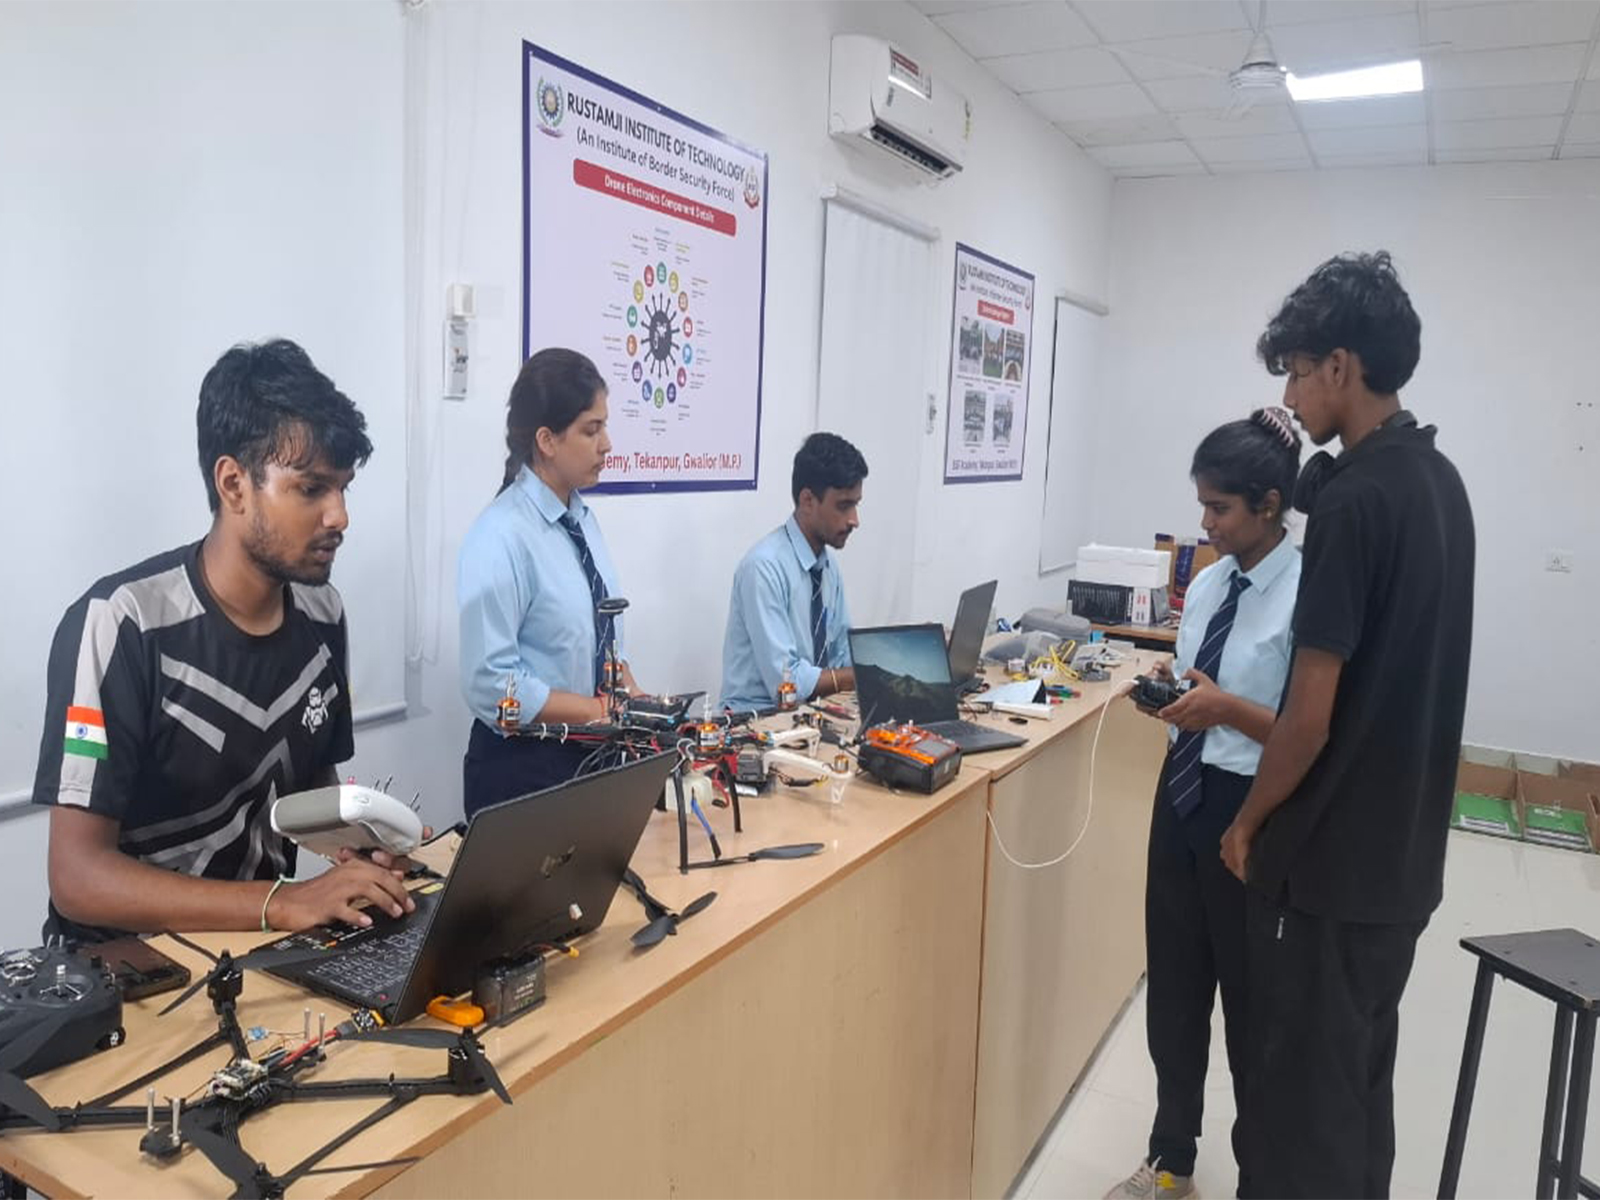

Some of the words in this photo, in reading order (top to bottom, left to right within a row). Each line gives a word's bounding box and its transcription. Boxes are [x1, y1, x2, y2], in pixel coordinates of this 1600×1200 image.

[567, 92, 622, 132] RUSTAMJI
[625, 116, 672, 153] INSTITUTE
[673, 138, 686, 158] OF
[688, 144, 745, 182] TECHNOLOGY
[577, 126, 594, 148] (An
[597, 135, 636, 163] Institute
[638, 152, 648, 167] of
[649, 156, 677, 178] Border
[680, 167, 710, 195] Security
[712, 181, 734, 202] Force)
[604, 174, 626, 193] Drone
[626, 181, 660, 204] Electronics
[606, 456, 631, 473] emy,
[634, 452, 681, 472] Tekanpur,
[683, 453, 717, 470] Gwalior
[719, 453, 742, 470] (M.P.)
